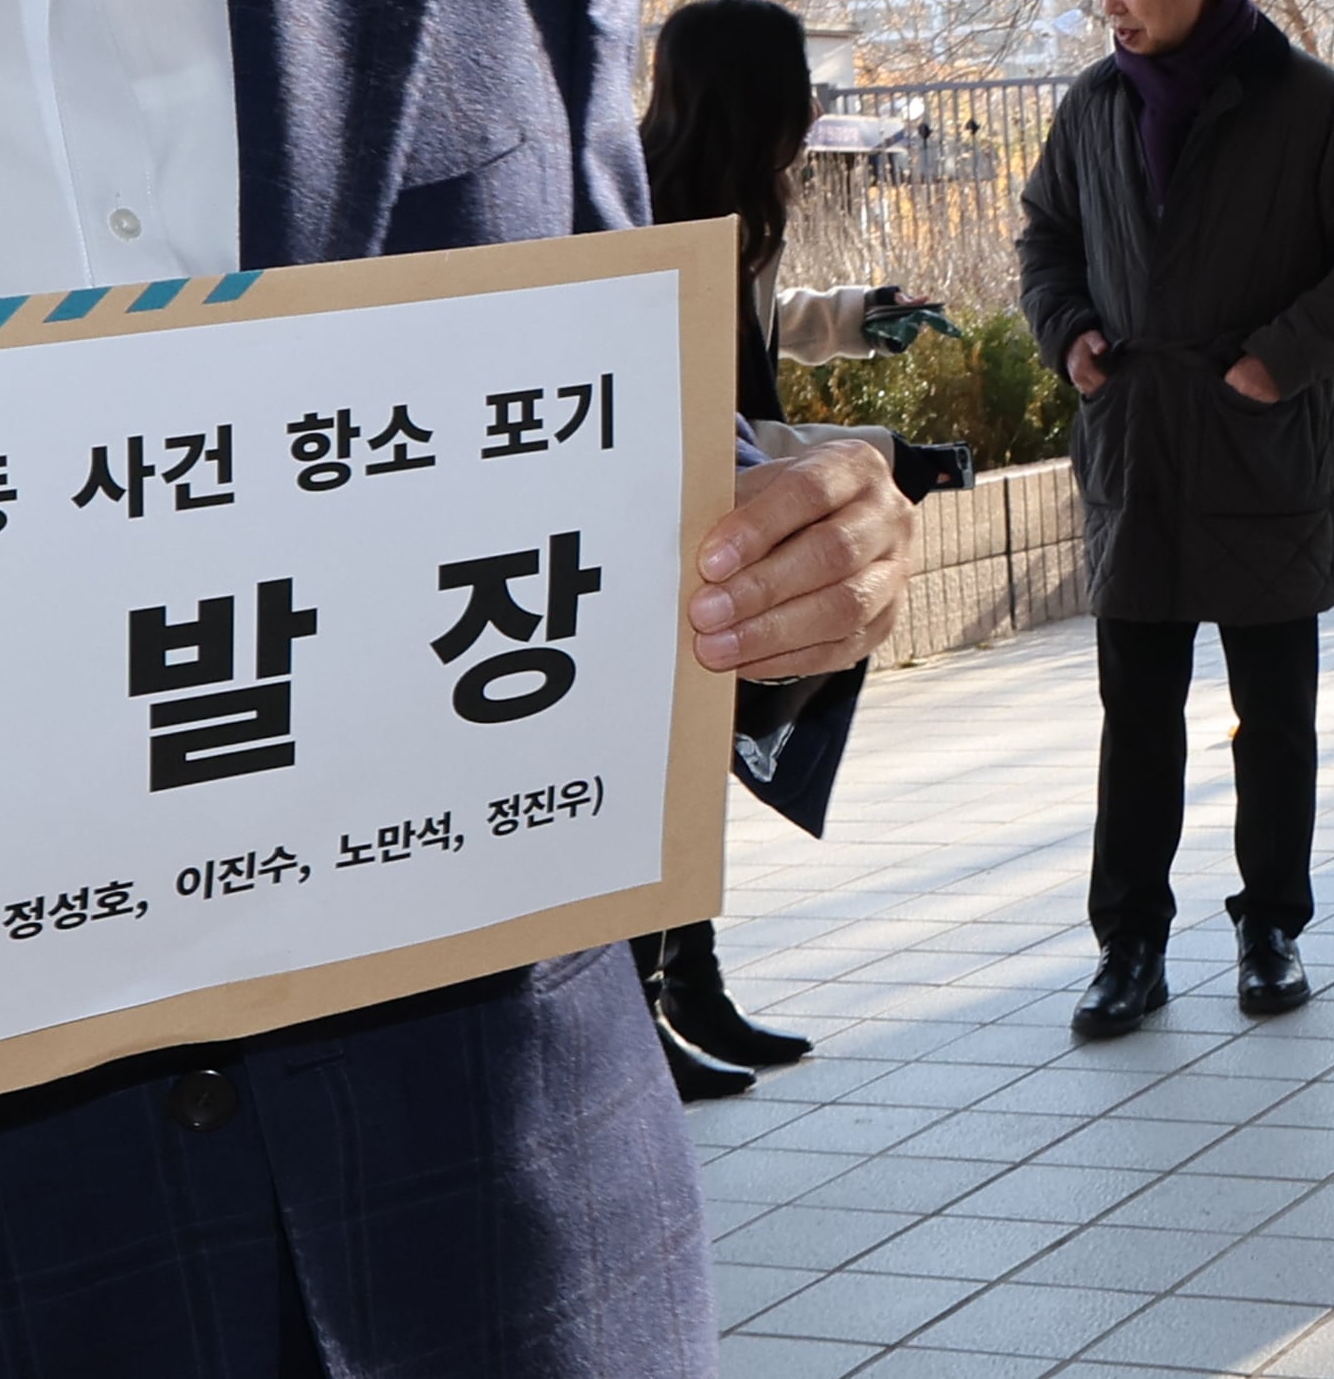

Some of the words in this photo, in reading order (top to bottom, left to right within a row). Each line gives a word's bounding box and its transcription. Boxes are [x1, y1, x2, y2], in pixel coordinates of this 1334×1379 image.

[70, 422, 236, 520] 사건
[285, 403, 437, 493] 항소
[480, 371, 615, 461] 포기
[1, 876, 150, 941] 정성호,
[175, 844, 312, 901] 이진수,
[334, 809, 466, 870] 노만석,
[485, 774, 605, 840] 정진우)
